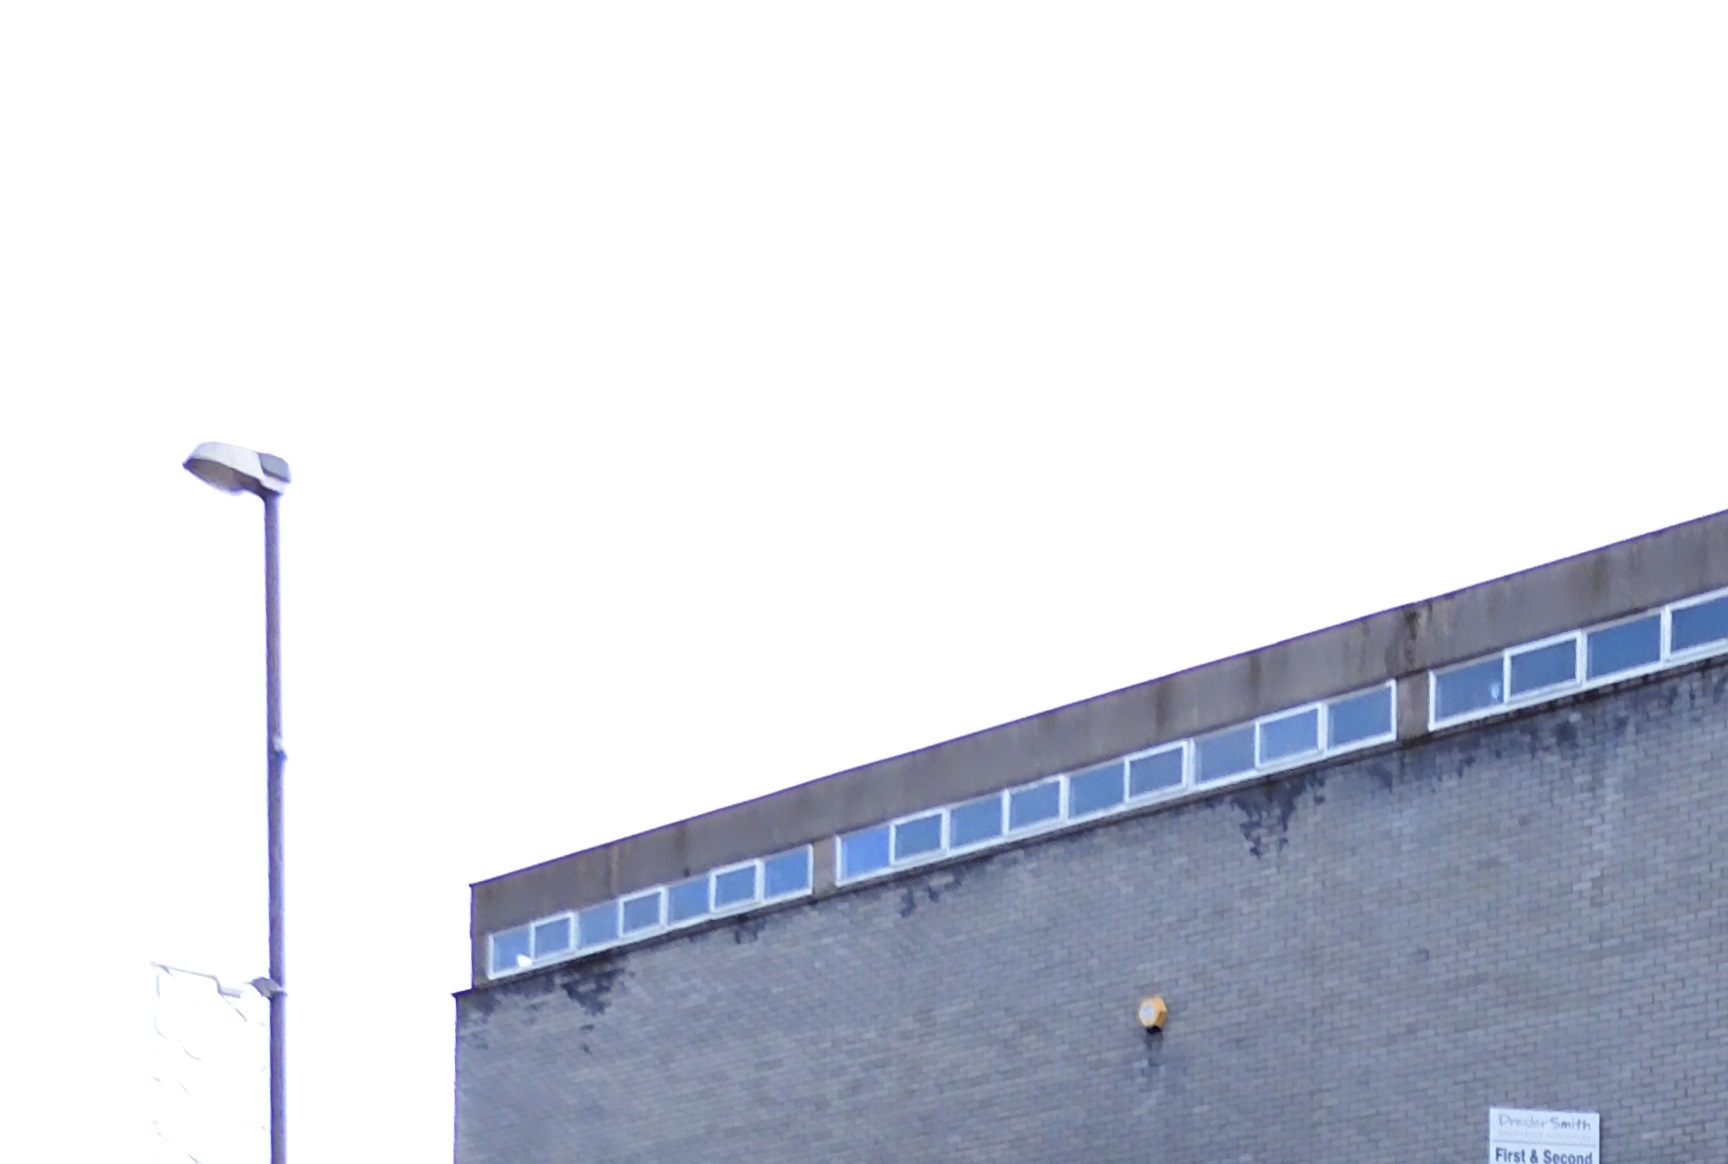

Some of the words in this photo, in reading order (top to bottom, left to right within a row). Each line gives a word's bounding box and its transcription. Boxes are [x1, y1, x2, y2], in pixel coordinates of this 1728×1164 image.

[1550, 1117, 1592, 1131] Smith
[1495, 1147, 1526, 1164] First
[1529, 1149, 1539, 1164] &
